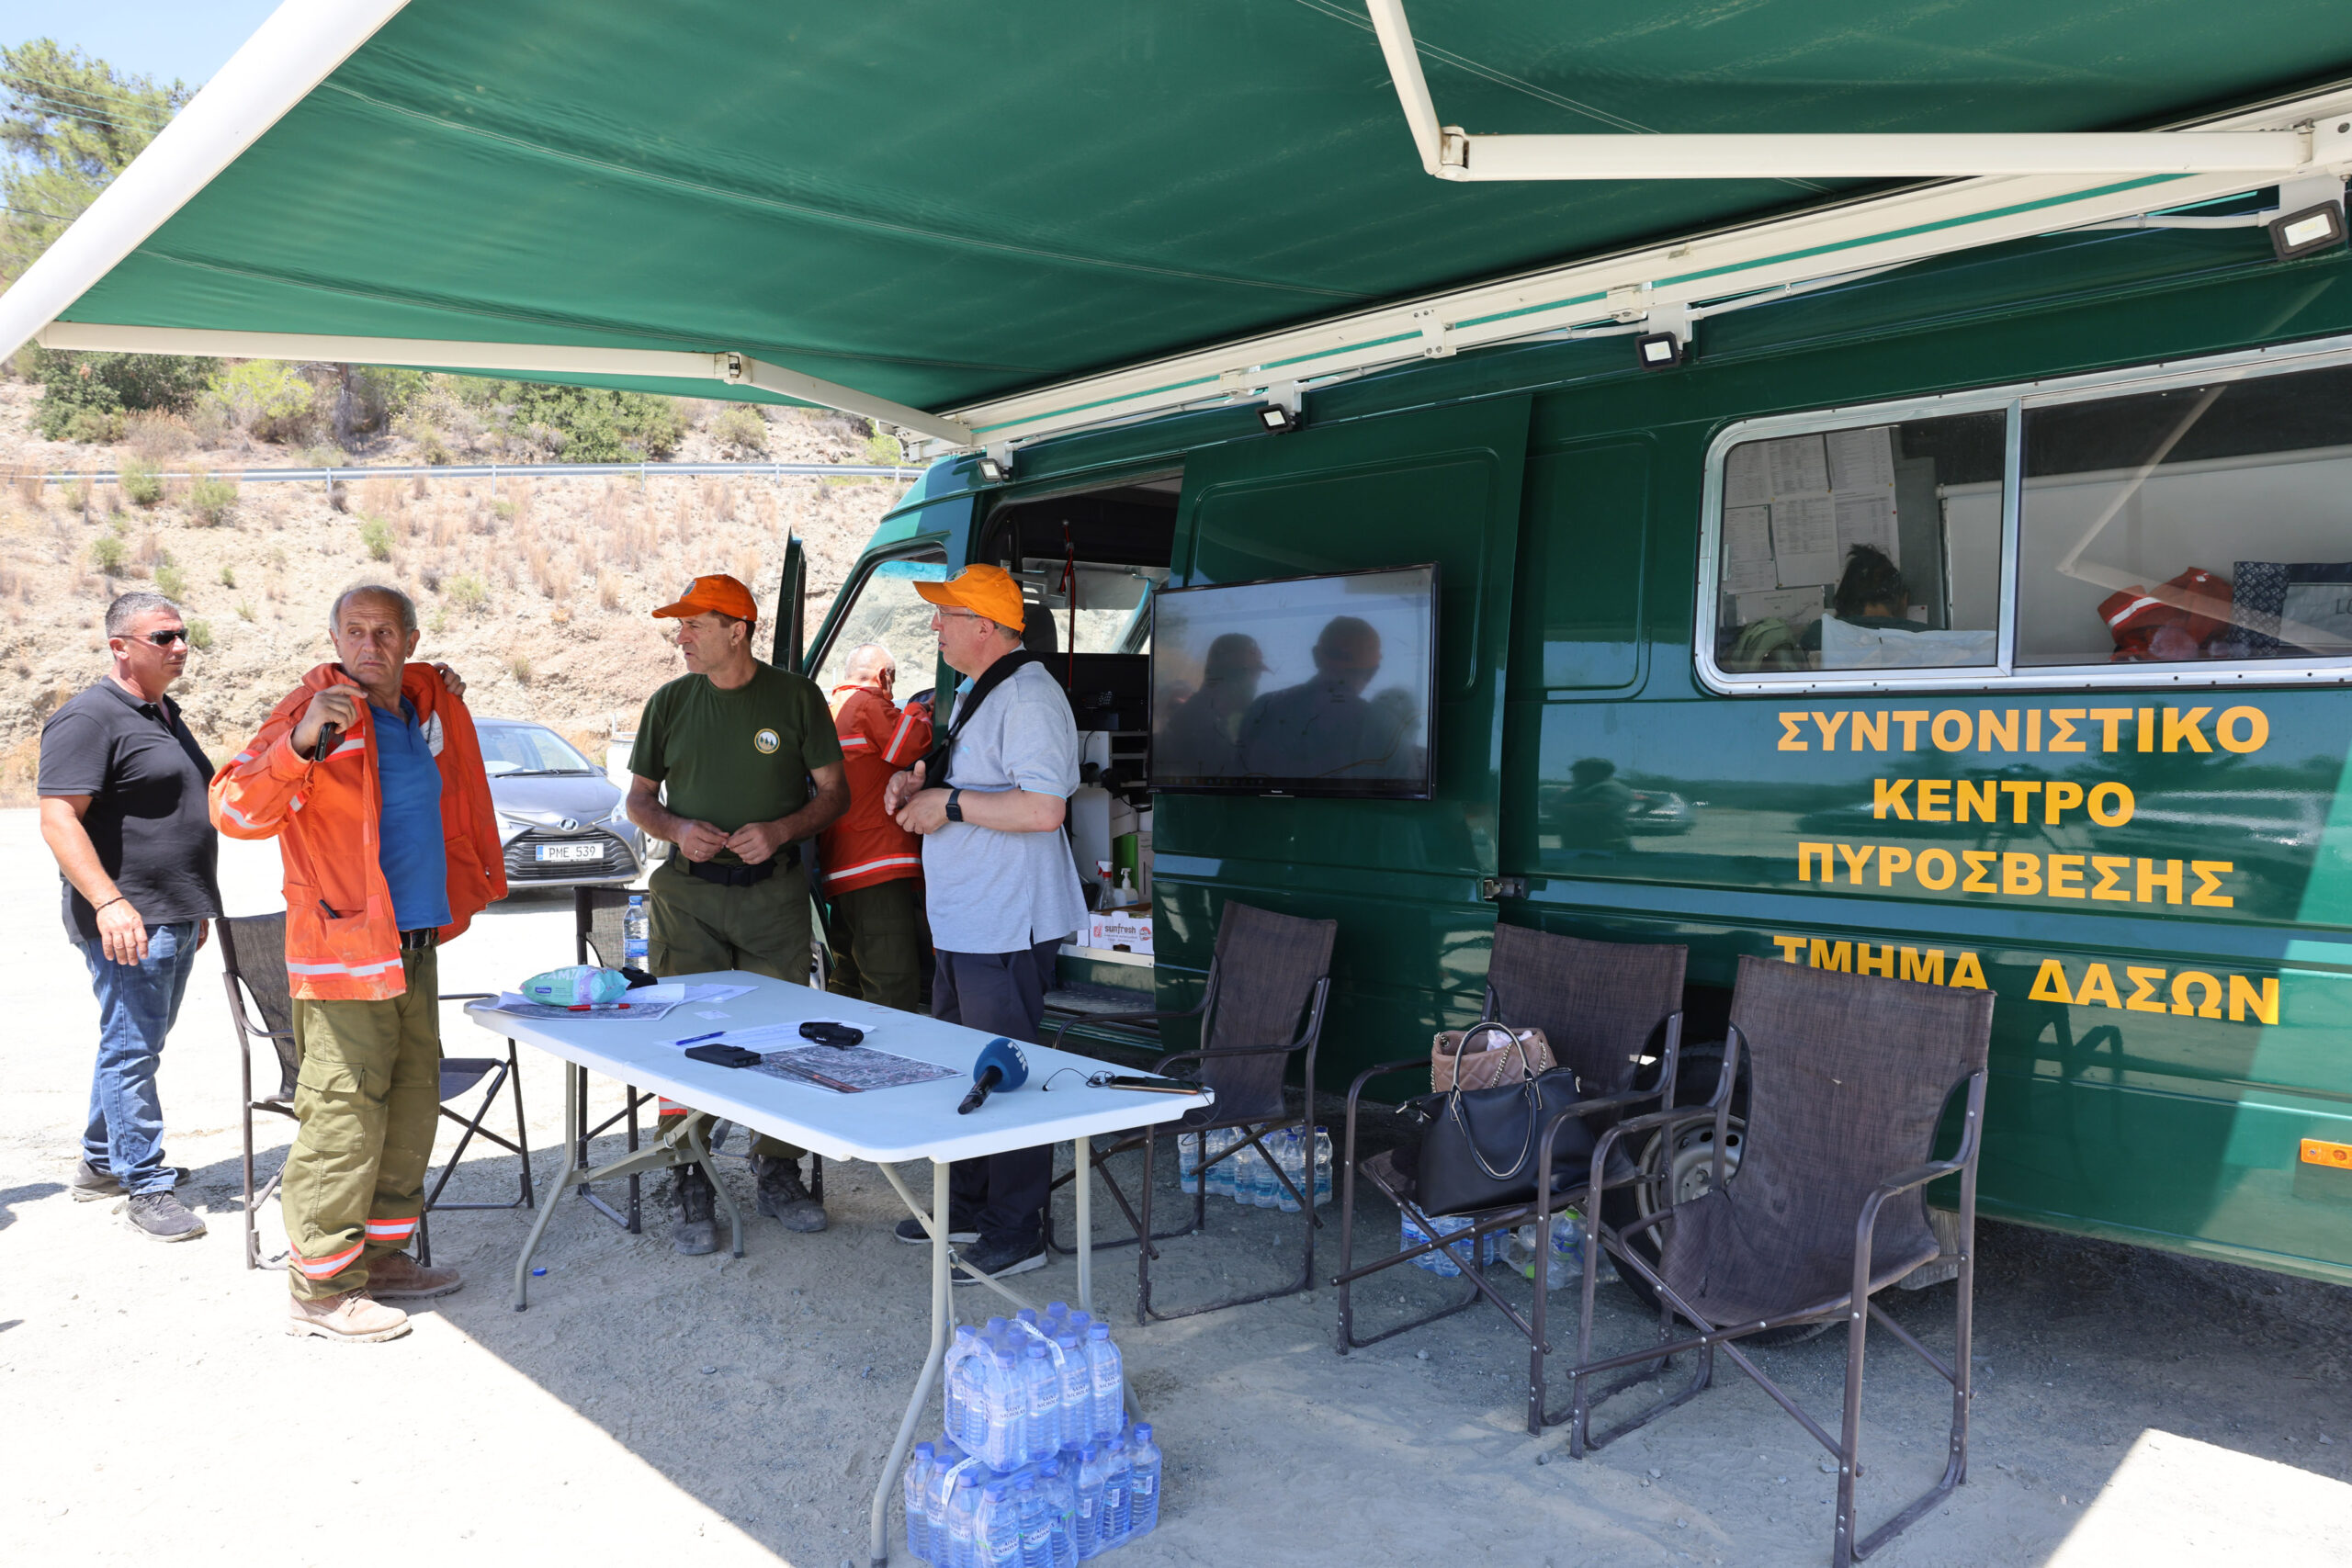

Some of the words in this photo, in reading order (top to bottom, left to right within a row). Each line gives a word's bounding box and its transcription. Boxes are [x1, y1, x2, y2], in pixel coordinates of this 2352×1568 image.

[1778, 706, 2269, 753] ΣΥΝΤΟΝΙΣΤΙΚΟ
[1873, 778, 2135, 828] ΚΕΝΤΡΟ
[548, 847, 570, 858] PME
[576, 846, 595, 857] 539
[1798, 841, 2234, 908] ΠΥΡΟΣΒΕΣΗΣ
[1104, 923, 1136, 934] sunfresh
[1773, 935, 1988, 990] ΤΜΗΜΑ
[2028, 958, 2279, 1025] ΔΑΣΩΝ
